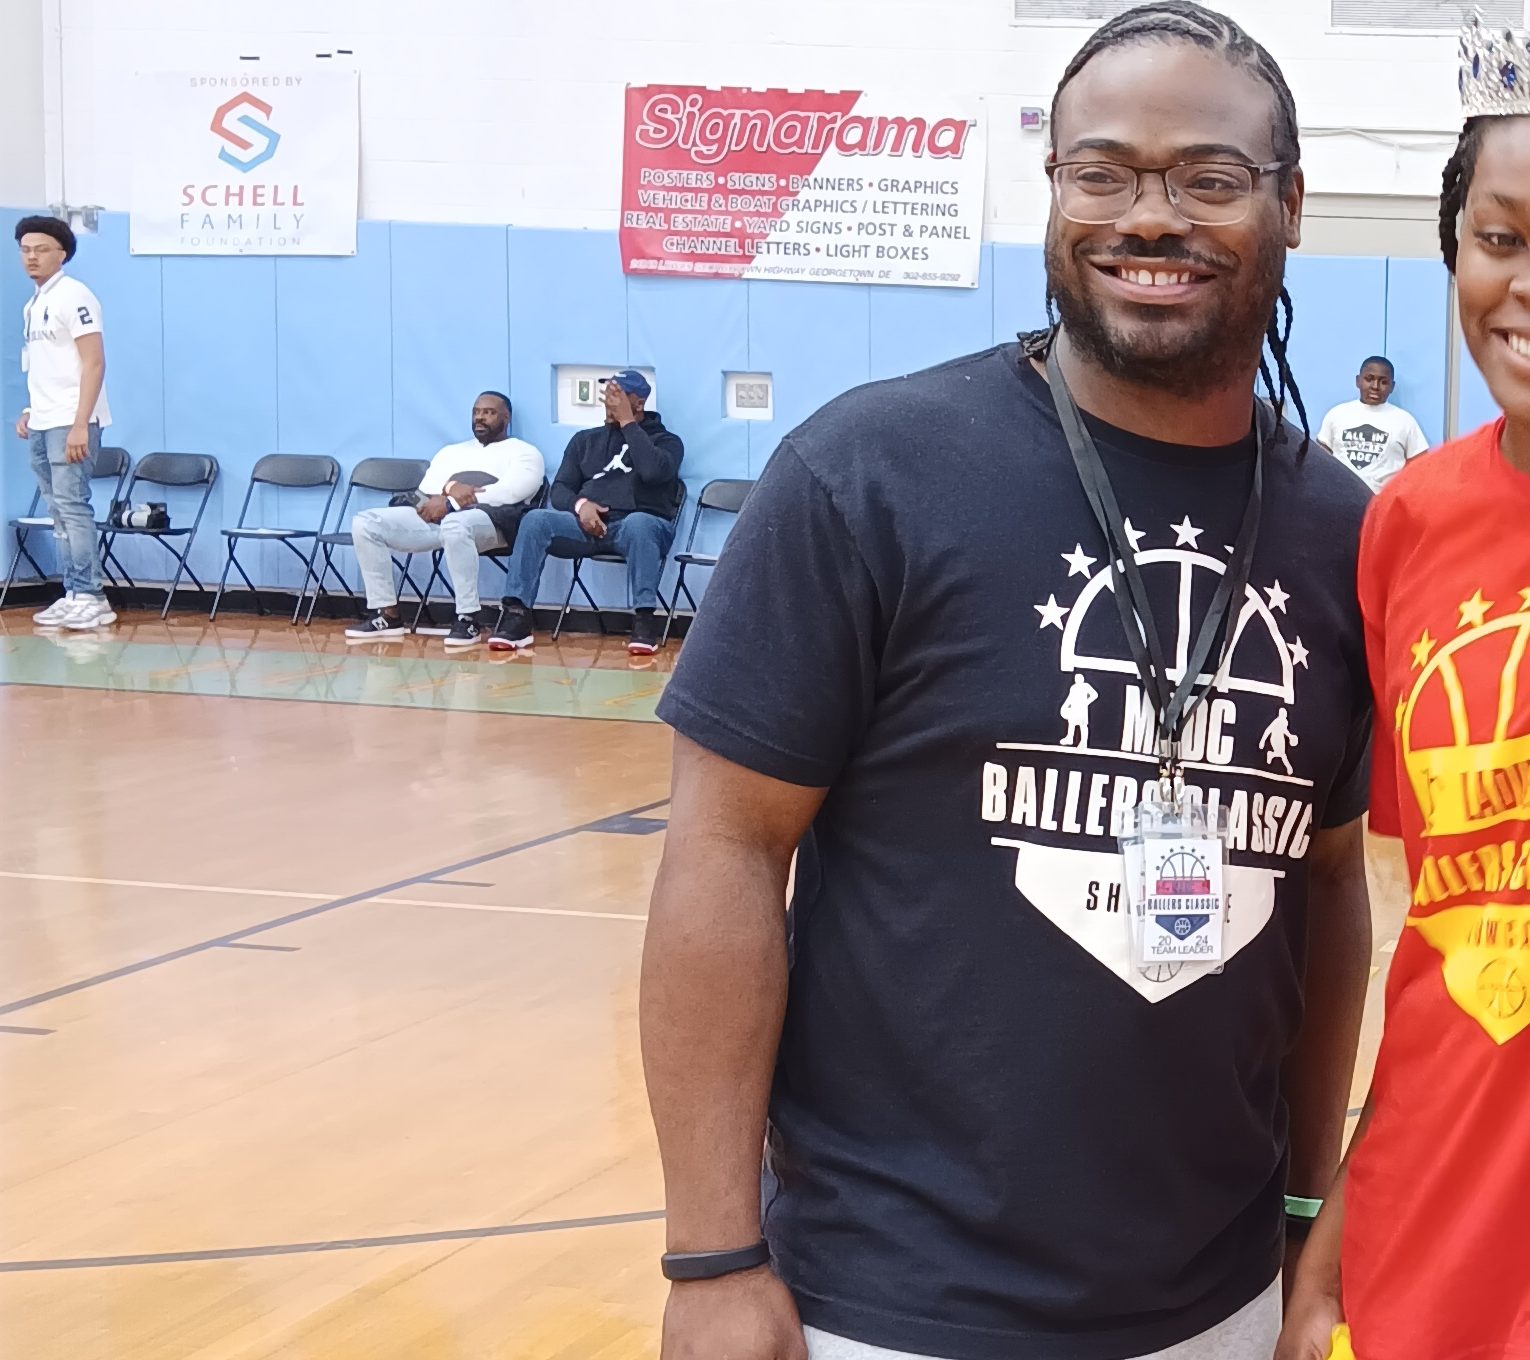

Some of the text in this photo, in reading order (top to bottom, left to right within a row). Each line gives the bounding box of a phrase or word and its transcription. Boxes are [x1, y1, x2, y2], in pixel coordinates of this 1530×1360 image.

[190, 76, 303, 87] SPONSORED BY
[635, 93, 977, 164] Signarama
[642, 170, 959, 195] POSTERS SIGNS BANNERS GRAPHICS
[181, 184, 305, 207] SCHELL
[639, 190, 706, 208] VEHICLE
[712, 196, 724, 208] &
[730, 197, 774, 211] BOAT
[779, 198, 858, 215] GRAPHICS
[872, 200, 959, 217] LETTERING
[180, 213, 305, 230] FAMILY
[625, 212, 971, 240] REAL ESTATE YARD SIGNS POST & PANEL
[180, 236, 301, 247] FOUNDATION
[664, 237, 929, 260] CHANNEL LETTERS LIGHT BOXES
[1121, 684, 1238, 765] MDC
[1186, 898, 1220, 910] CLASSIC
[1152, 946, 1213, 954] TEAM LEADER
[1158, 935, 1208, 946] 20 24
